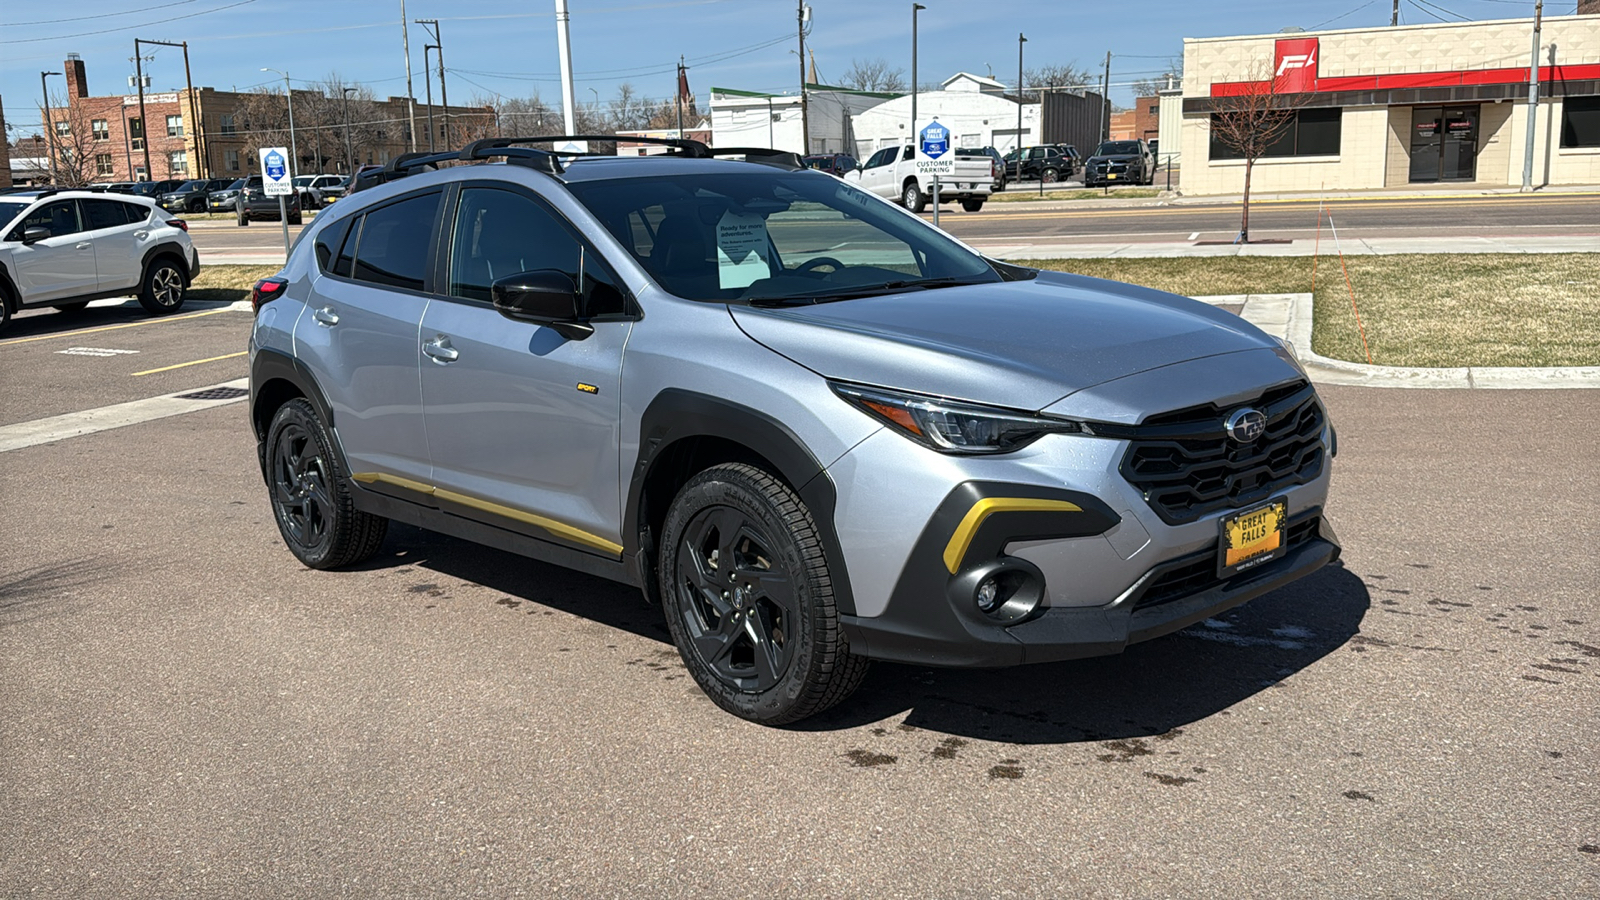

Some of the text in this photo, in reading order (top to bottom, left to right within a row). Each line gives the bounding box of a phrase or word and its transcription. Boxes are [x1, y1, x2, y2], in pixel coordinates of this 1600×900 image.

[916, 160, 953, 168] CUSTOMER
[577, 383, 596, 393] SPORT
[1242, 513, 1266, 531] GREAT
[1242, 525, 1266, 545] FALLS
